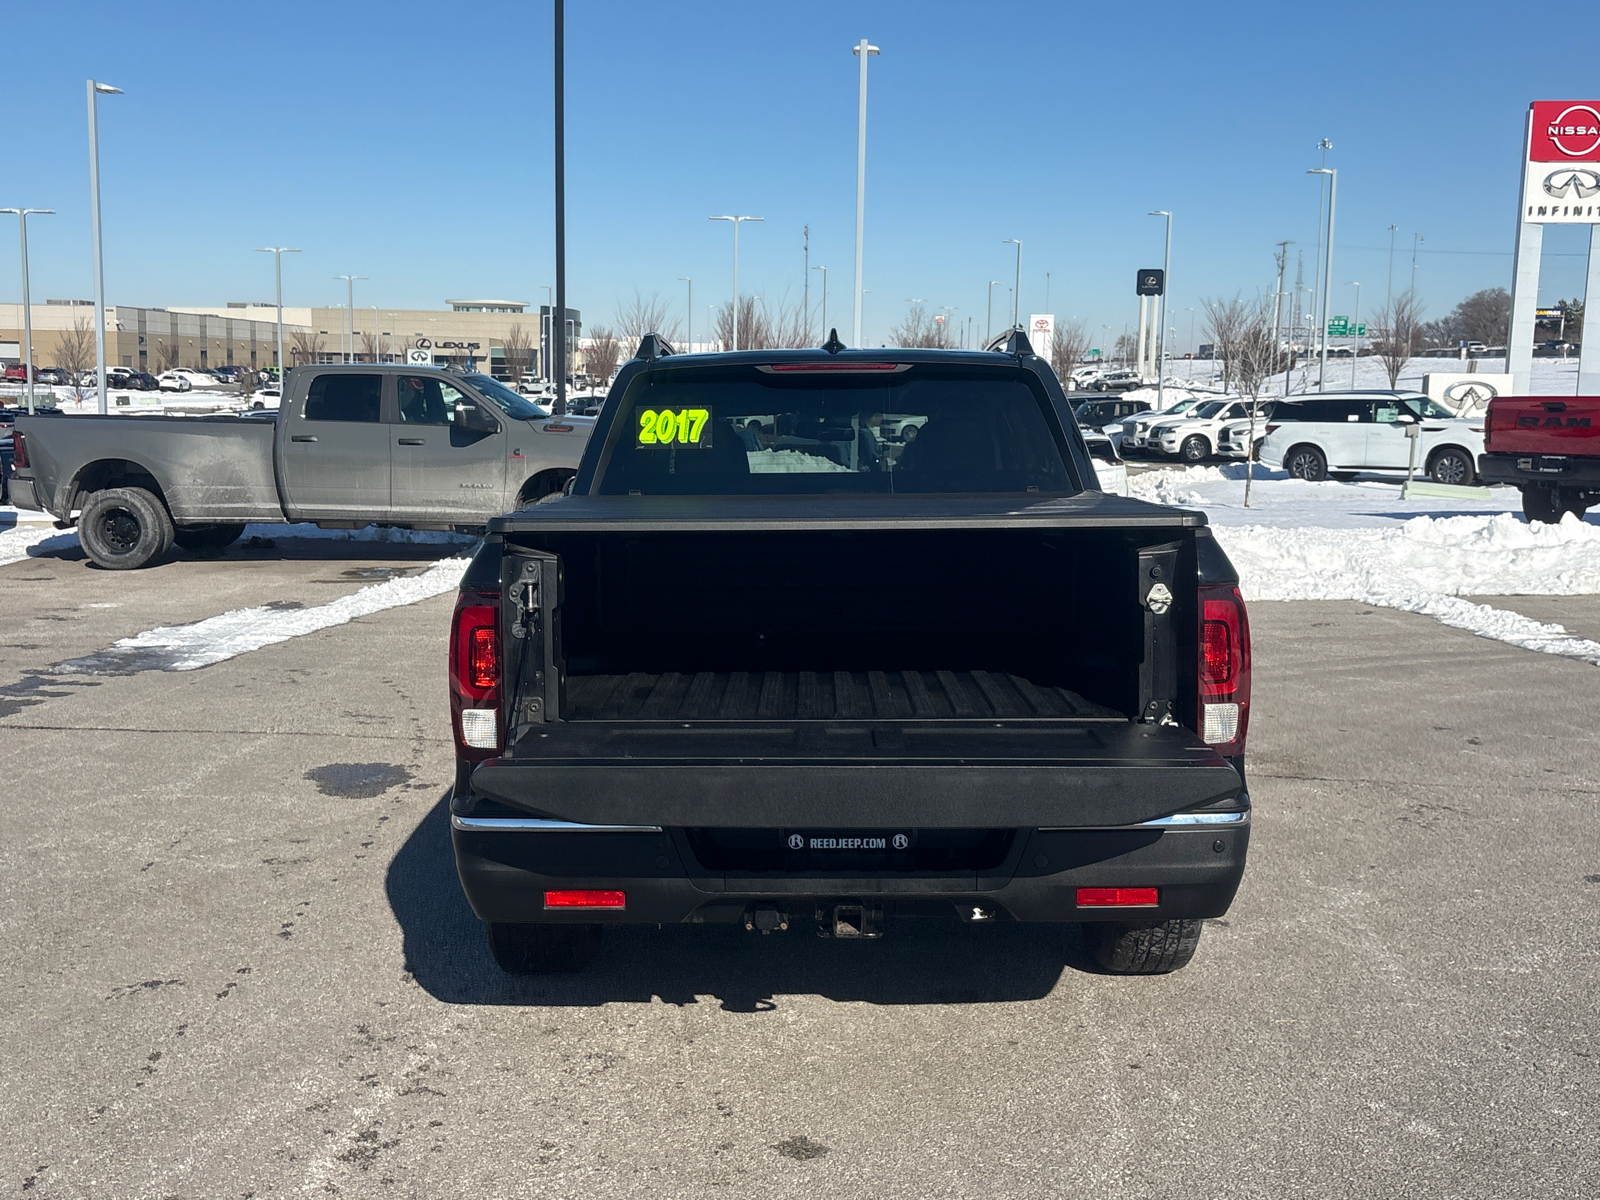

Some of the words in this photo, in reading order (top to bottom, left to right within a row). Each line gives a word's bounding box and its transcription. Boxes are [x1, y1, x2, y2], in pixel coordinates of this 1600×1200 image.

[1547, 126, 1600, 135] NISSA
[434, 341, 480, 350] LEXUS
[639, 409, 709, 444] 2017
[1518, 416, 1592, 429] RAM
[810, 838, 886, 849] REEDJEEP.COM
